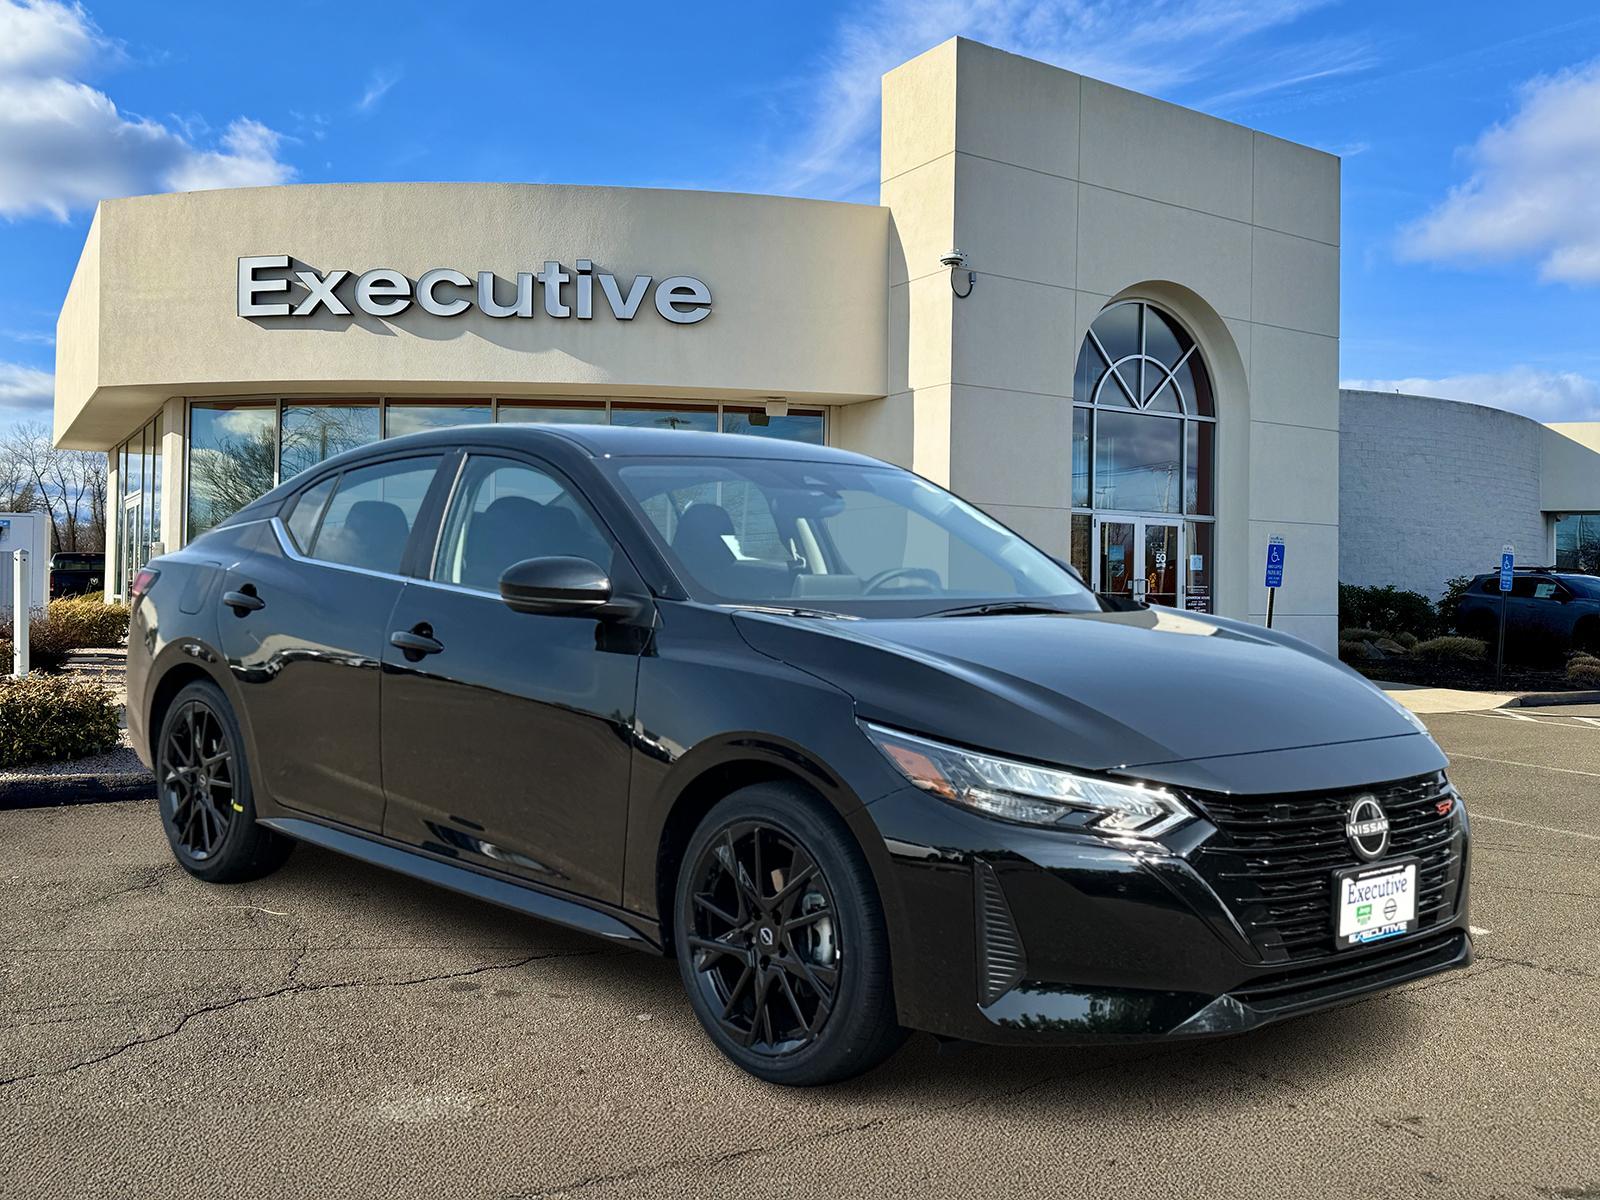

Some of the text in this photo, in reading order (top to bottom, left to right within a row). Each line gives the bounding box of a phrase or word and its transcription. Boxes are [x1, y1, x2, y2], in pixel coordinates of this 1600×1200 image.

[237, 254, 713, 325] Executive
[1348, 821, 1389, 837] NISSAN
[1347, 876, 1408, 905] Executive
